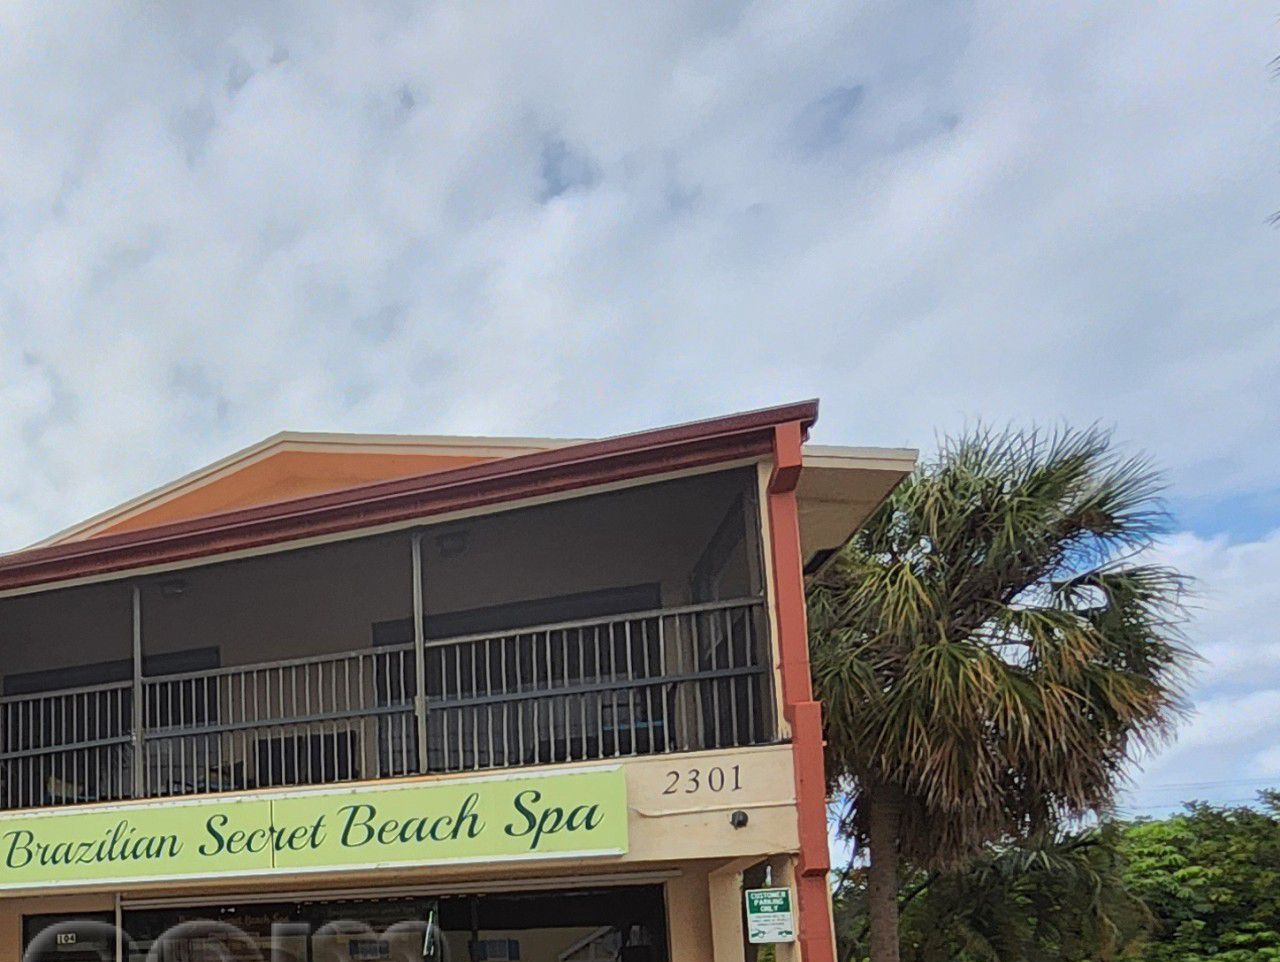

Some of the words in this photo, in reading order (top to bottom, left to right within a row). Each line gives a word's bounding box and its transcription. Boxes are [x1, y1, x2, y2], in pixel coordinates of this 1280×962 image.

[662, 765, 743, 795] 2301
[3, 820, 183, 869] Brazilian
[198, 813, 327, 857] Secret
[337, 791, 486, 848] Beach
[504, 789, 603, 852] Spa
